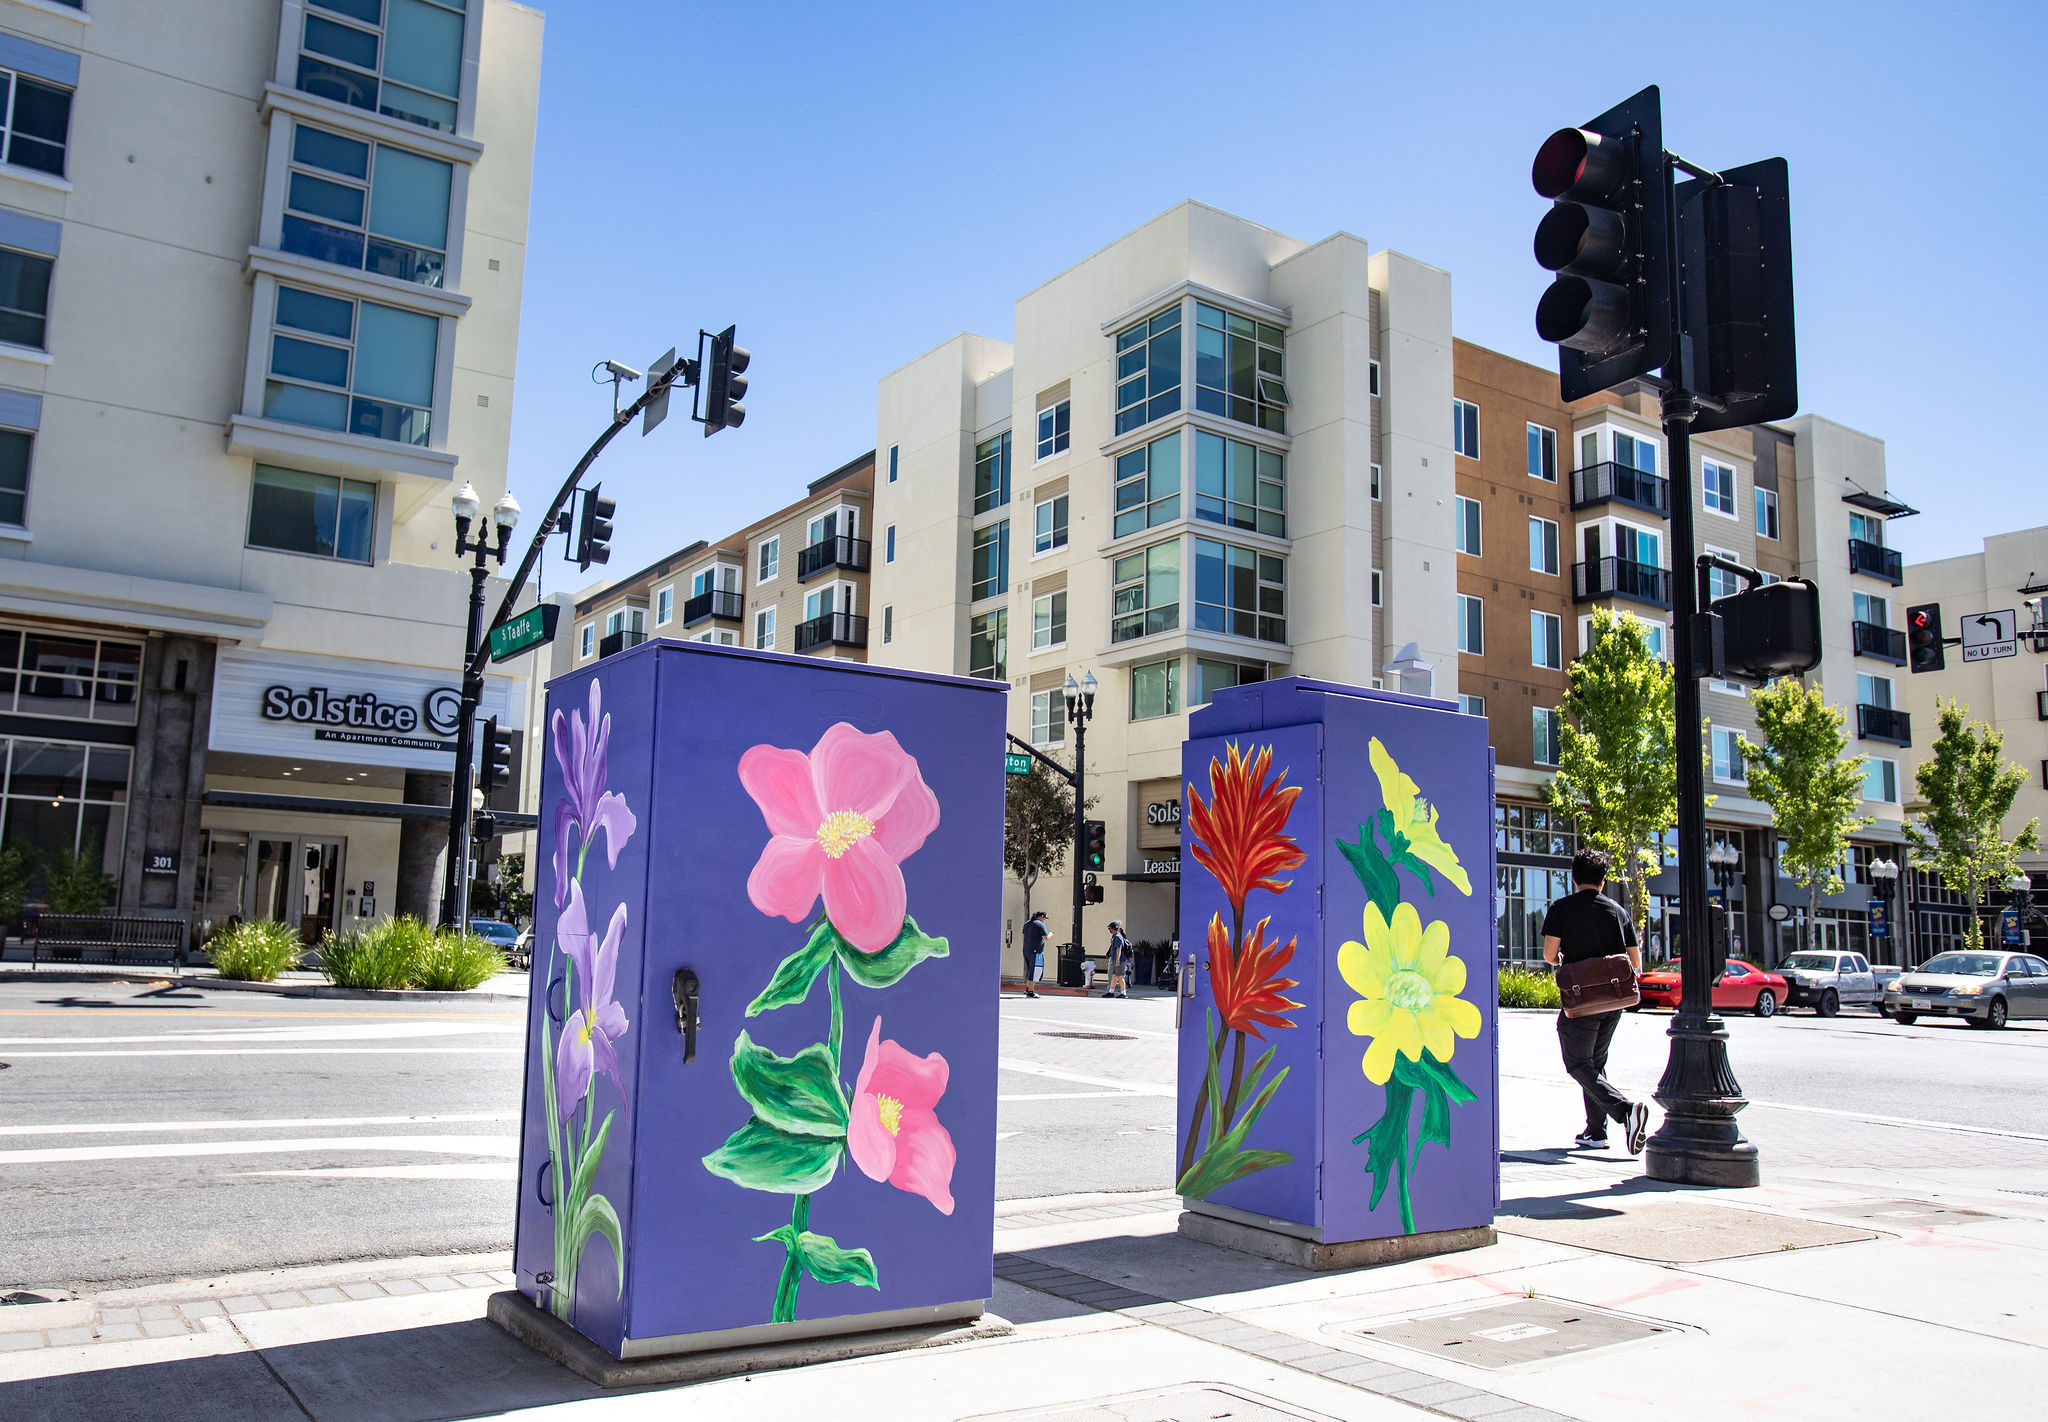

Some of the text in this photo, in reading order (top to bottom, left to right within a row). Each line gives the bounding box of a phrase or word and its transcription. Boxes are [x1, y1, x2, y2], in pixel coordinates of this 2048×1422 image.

[507, 619, 531, 641] Taaffe
[1980, 647, 1990, 656] U
[1992, 645, 2012, 654] TURN
[265, 686, 417, 732] Solstice
[325, 731, 442, 749] An Apartment Community
[1148, 799, 1181, 825] Sols
[153, 856, 172, 868] 301
